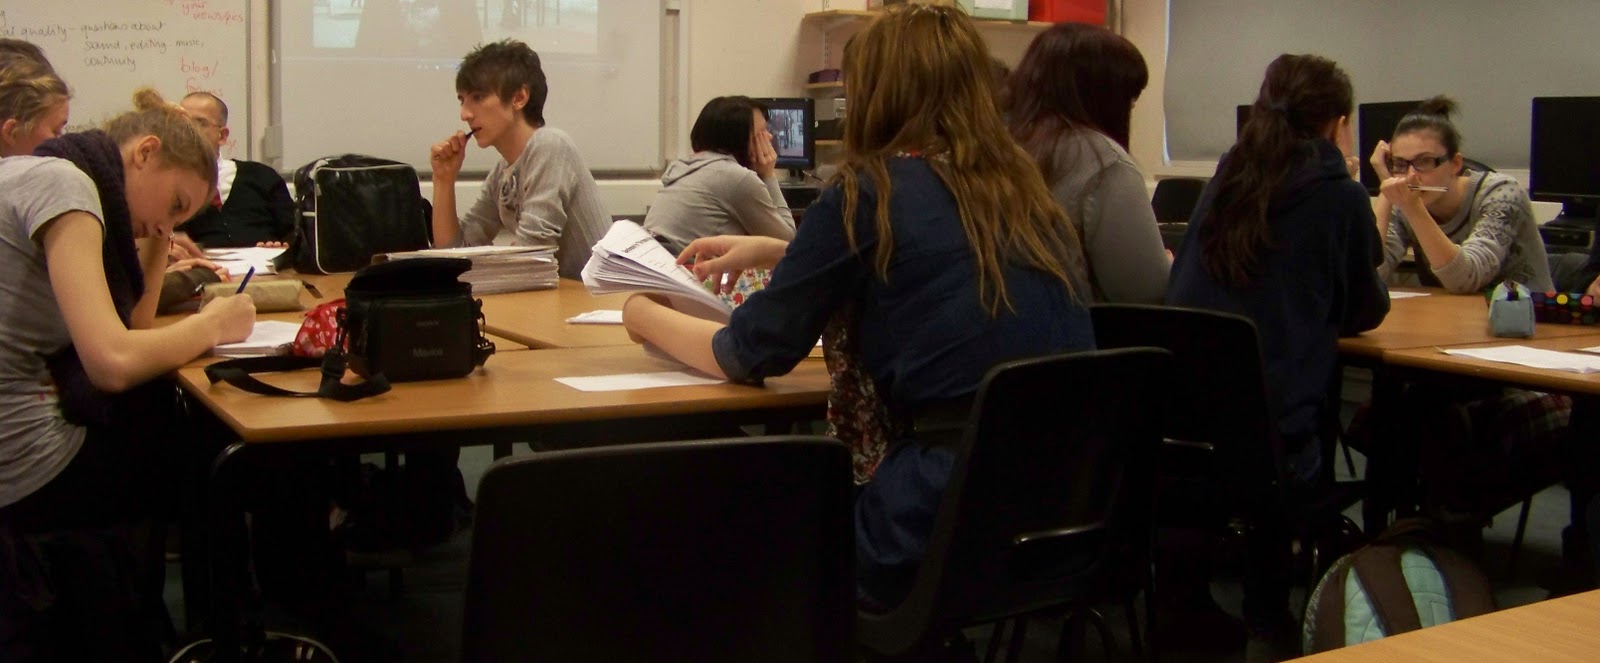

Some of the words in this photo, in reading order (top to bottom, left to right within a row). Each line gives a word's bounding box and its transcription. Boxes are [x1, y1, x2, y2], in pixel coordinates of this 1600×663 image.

[21, 24, 67, 42] quality
[81, 21, 128, 39] questions
[131, 21, 164, 31] about
